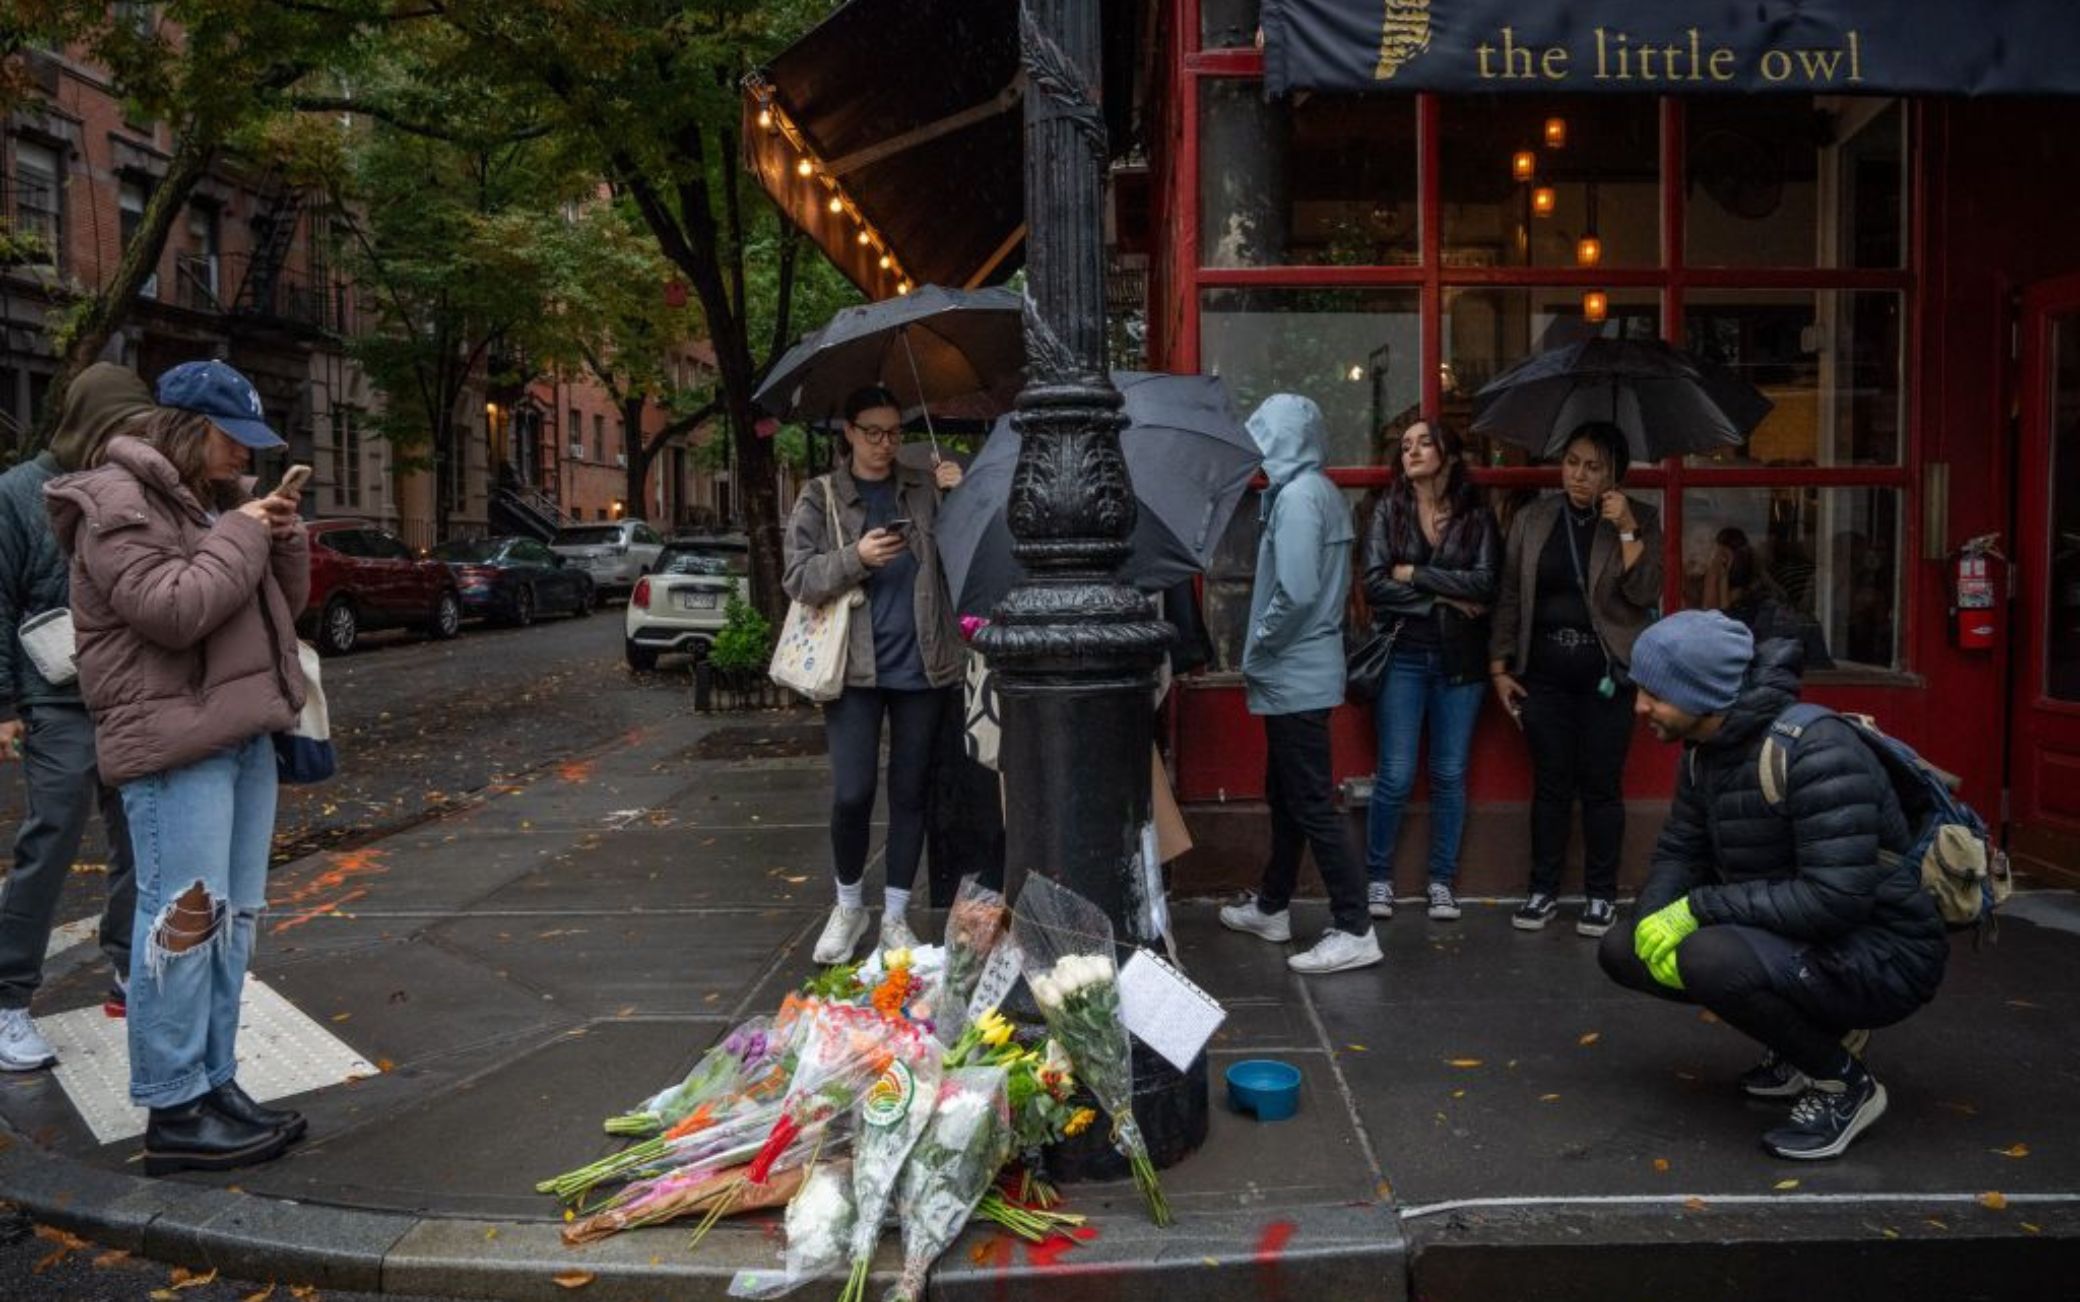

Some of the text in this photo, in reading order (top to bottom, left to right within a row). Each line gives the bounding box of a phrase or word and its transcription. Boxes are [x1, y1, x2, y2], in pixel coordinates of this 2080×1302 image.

[1476, 27, 1863, 81] the little owl
